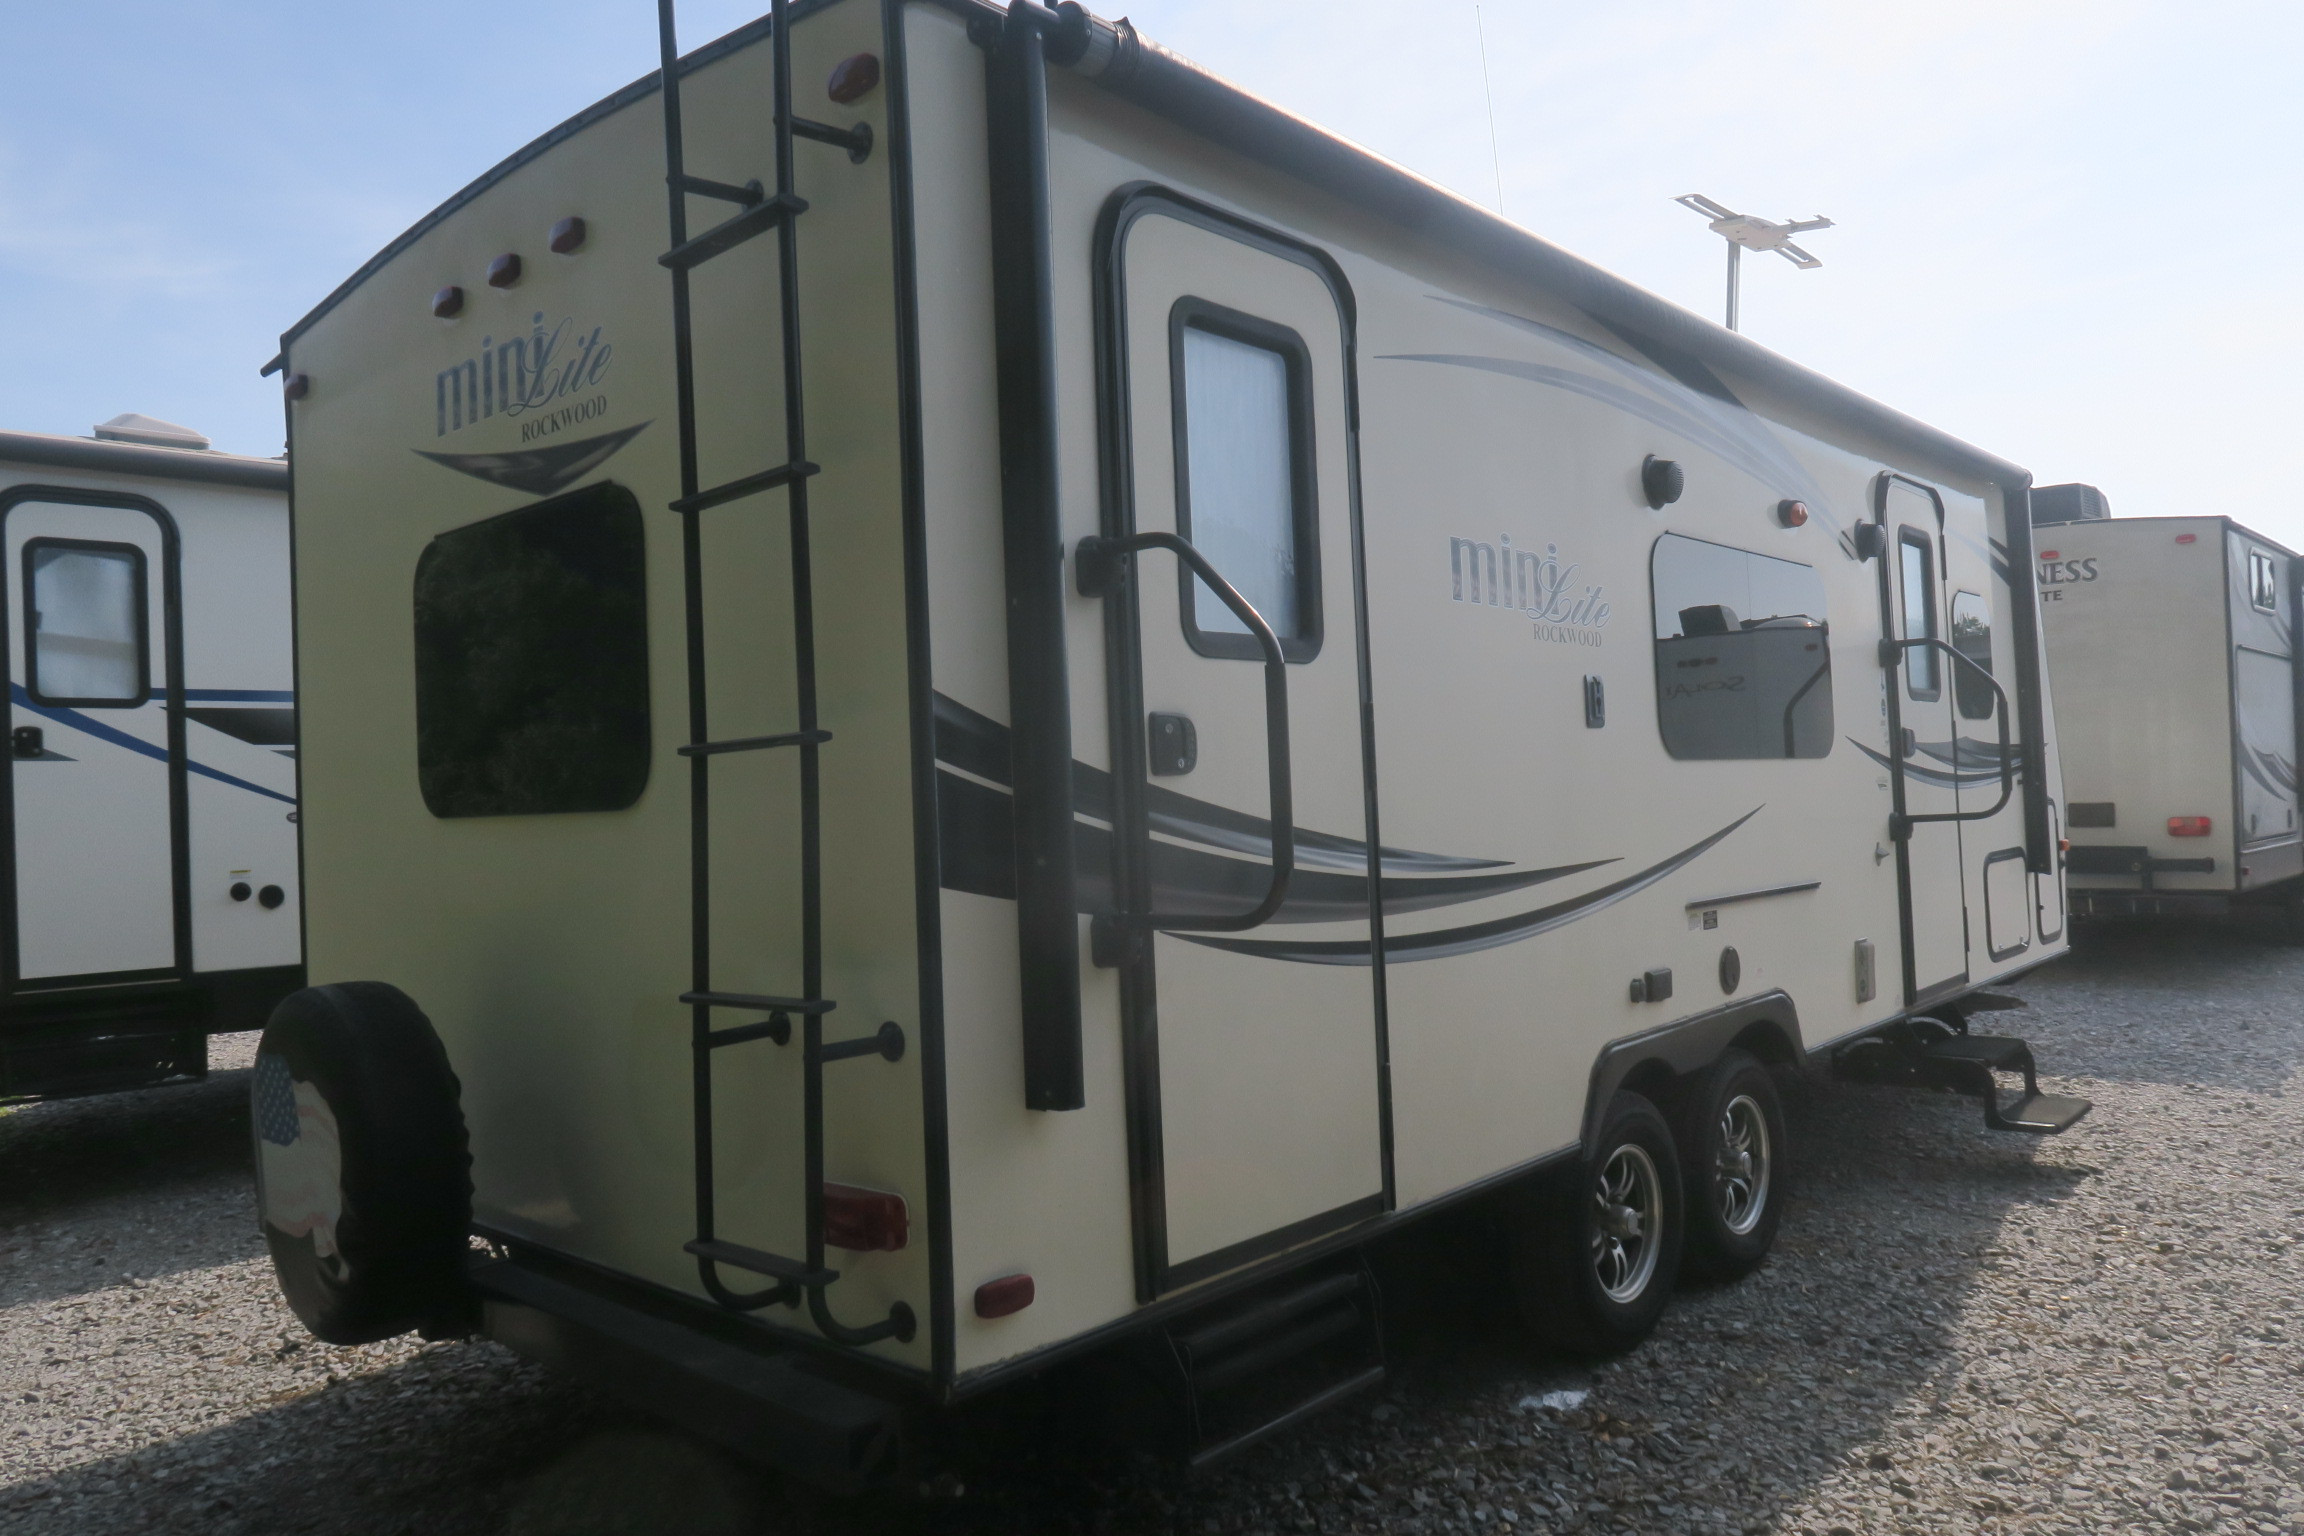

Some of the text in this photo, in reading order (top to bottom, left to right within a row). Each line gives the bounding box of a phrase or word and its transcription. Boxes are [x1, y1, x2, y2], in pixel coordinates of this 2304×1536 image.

[436, 310, 613, 438] mini Lite
[521, 395, 608, 443] ROCKWOOD
[1450, 532, 1611, 628] mini Lite
[1532, 622, 1602, 647] ROCKWOOD
